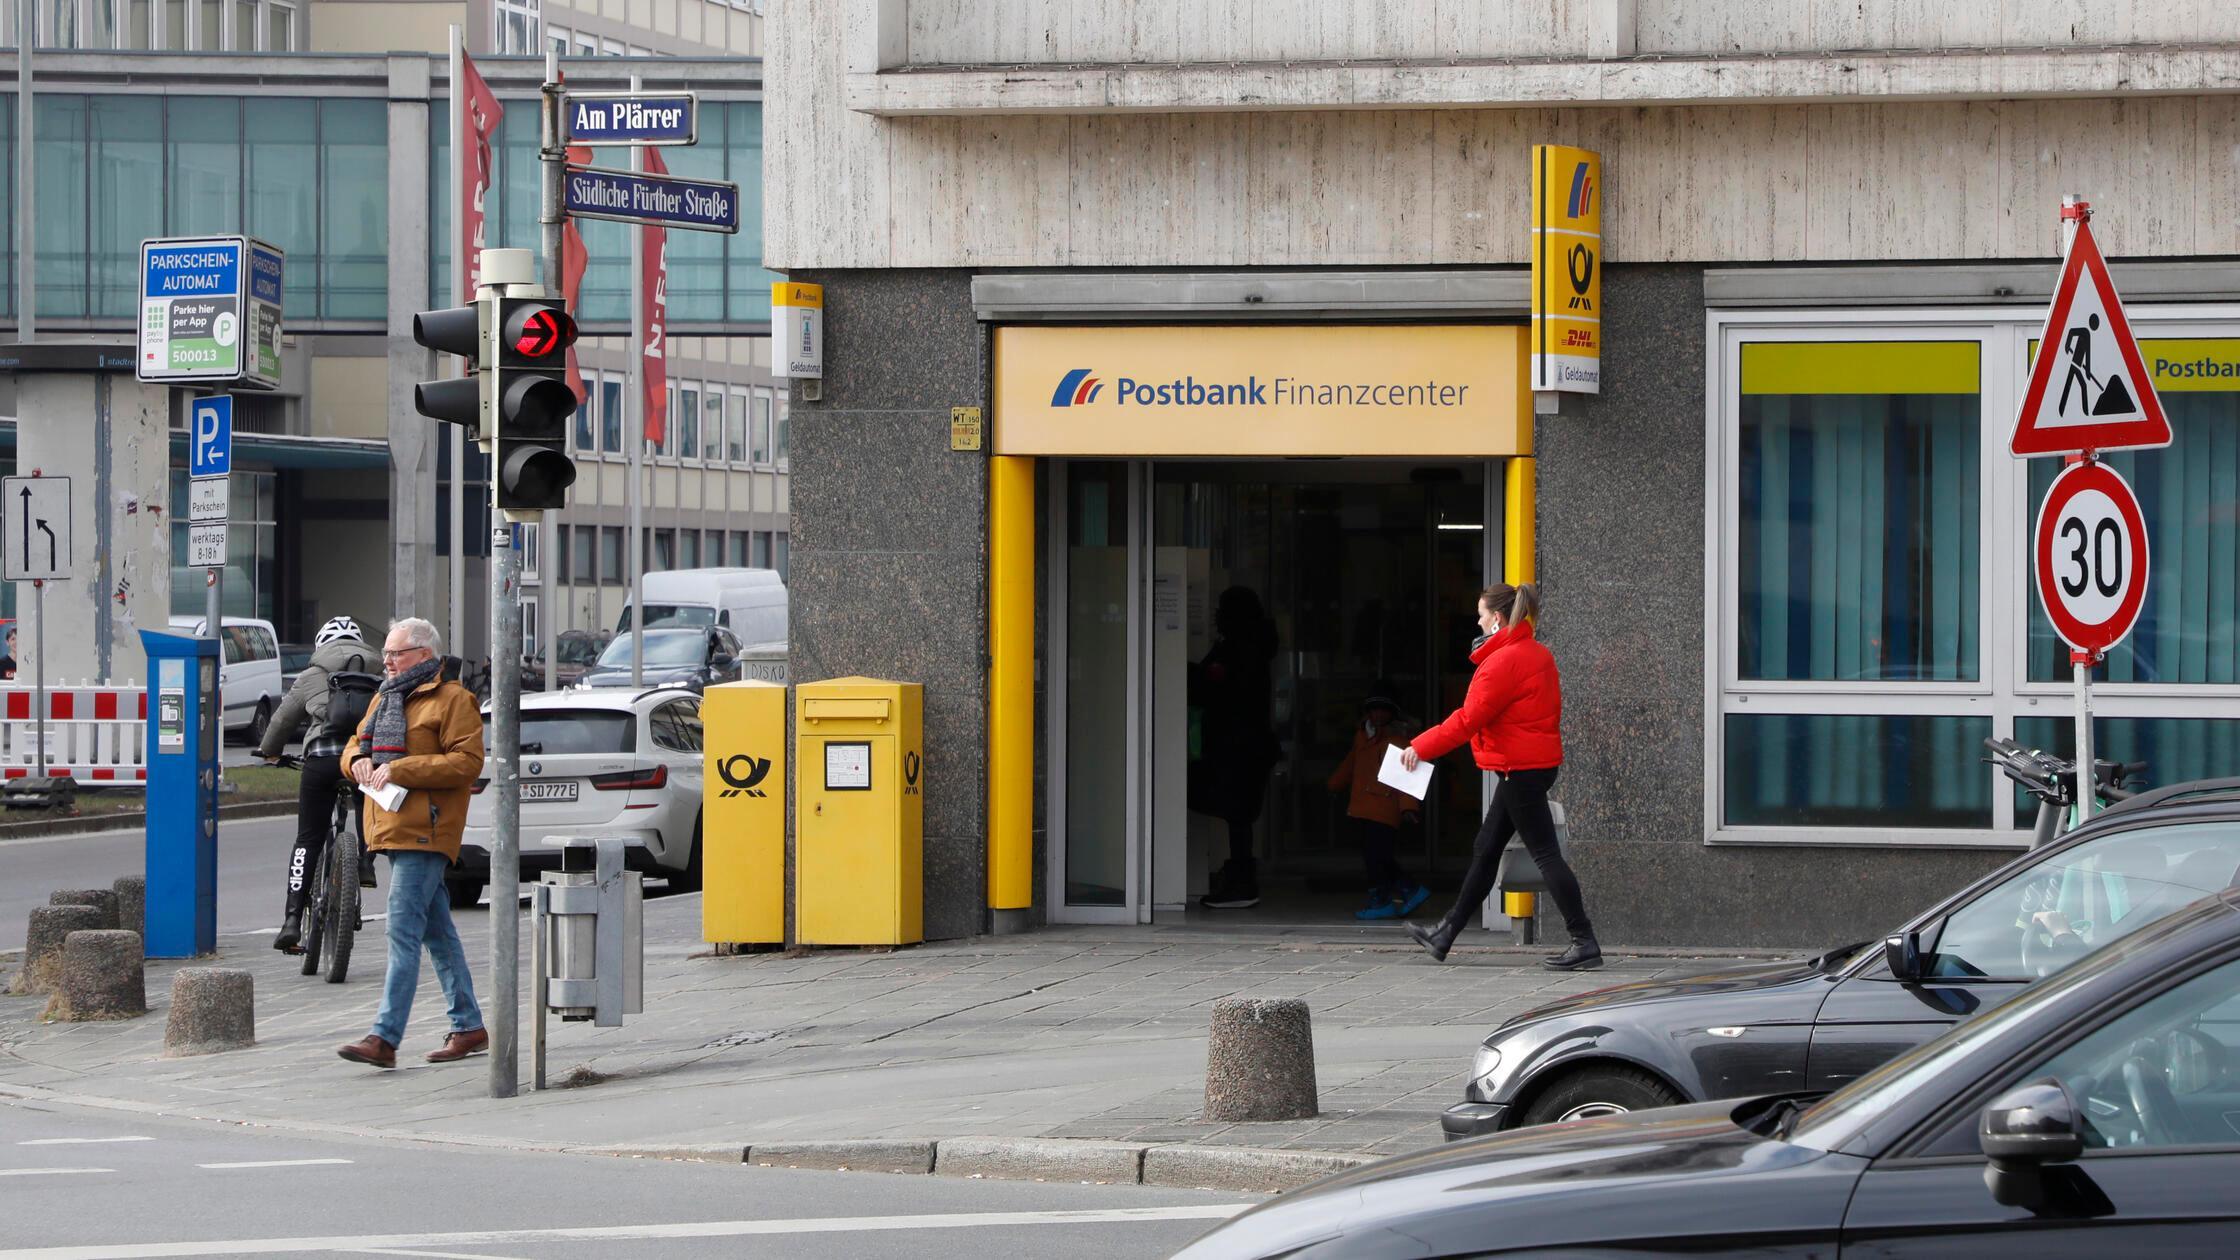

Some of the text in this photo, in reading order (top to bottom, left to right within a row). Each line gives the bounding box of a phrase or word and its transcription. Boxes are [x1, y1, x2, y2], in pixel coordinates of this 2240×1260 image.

[576, 103, 681, 130] Am Plärrer
[573, 177, 728, 221] Südliche Fürther Straße
[151, 252, 234, 270] PARKSCHEIN-
[162, 274, 221, 290] AUTOMAT
[173, 304, 215, 315] Parke hier
[173, 316, 207, 329] per App
[1567, 329, 1593, 347] DHL
[173, 349, 217, 363] 500013
[1565, 366, 1599, 383] Geldautomat
[1118, 376, 1469, 406] Postbank Finanzcenter
[197, 408, 219, 466] P
[204, 489, 214, 498] mit
[192, 502, 226, 513] Parkschein
[192, 532, 225, 546] werktags
[2061, 516, 2122, 598] 30
[289, 848, 306, 892] didas
